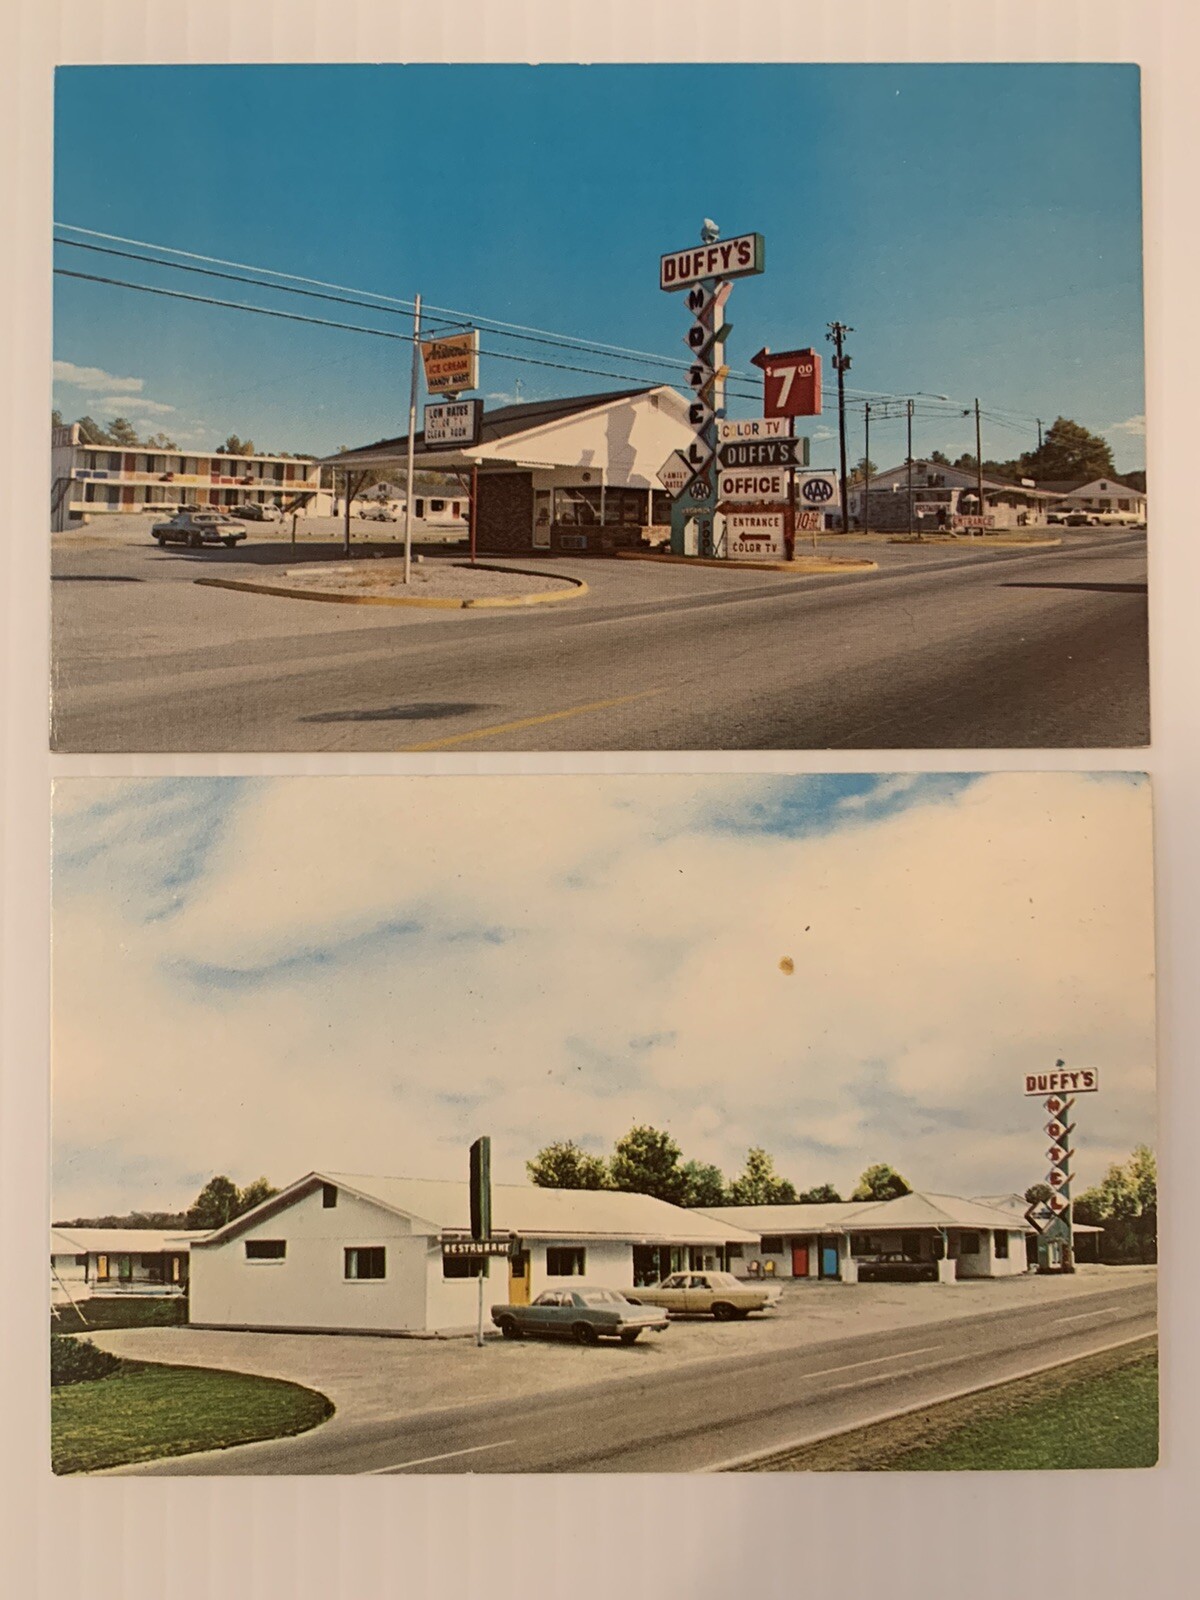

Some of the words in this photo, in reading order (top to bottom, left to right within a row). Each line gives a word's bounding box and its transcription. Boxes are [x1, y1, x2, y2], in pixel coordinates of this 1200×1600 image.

[663, 240, 751, 283] DUFFY'S
[429, 365, 441, 374] ICE
[442, 361, 467, 372] CREAM
[688, 288, 705, 464] MOTEL
[446, 405, 468, 416] RATES
[722, 422, 760, 438] COLOR
[764, 421, 781, 435] TV
[727, 442, 790, 464] DUFFY'S
[663, 471, 688, 481] FAMILY
[722, 475, 781, 495] OFFICE
[805, 479, 830, 502] AAA
[732, 517, 780, 528] ENTRANCE
[953, 517, 992, 527] ENTRANCE
[732, 541, 762, 553] COLOR
[765, 540, 778, 553] TV
[1026, 1070, 1094, 1092] DUFFY'S
[1047, 1099, 1063, 1210] MOTEL
